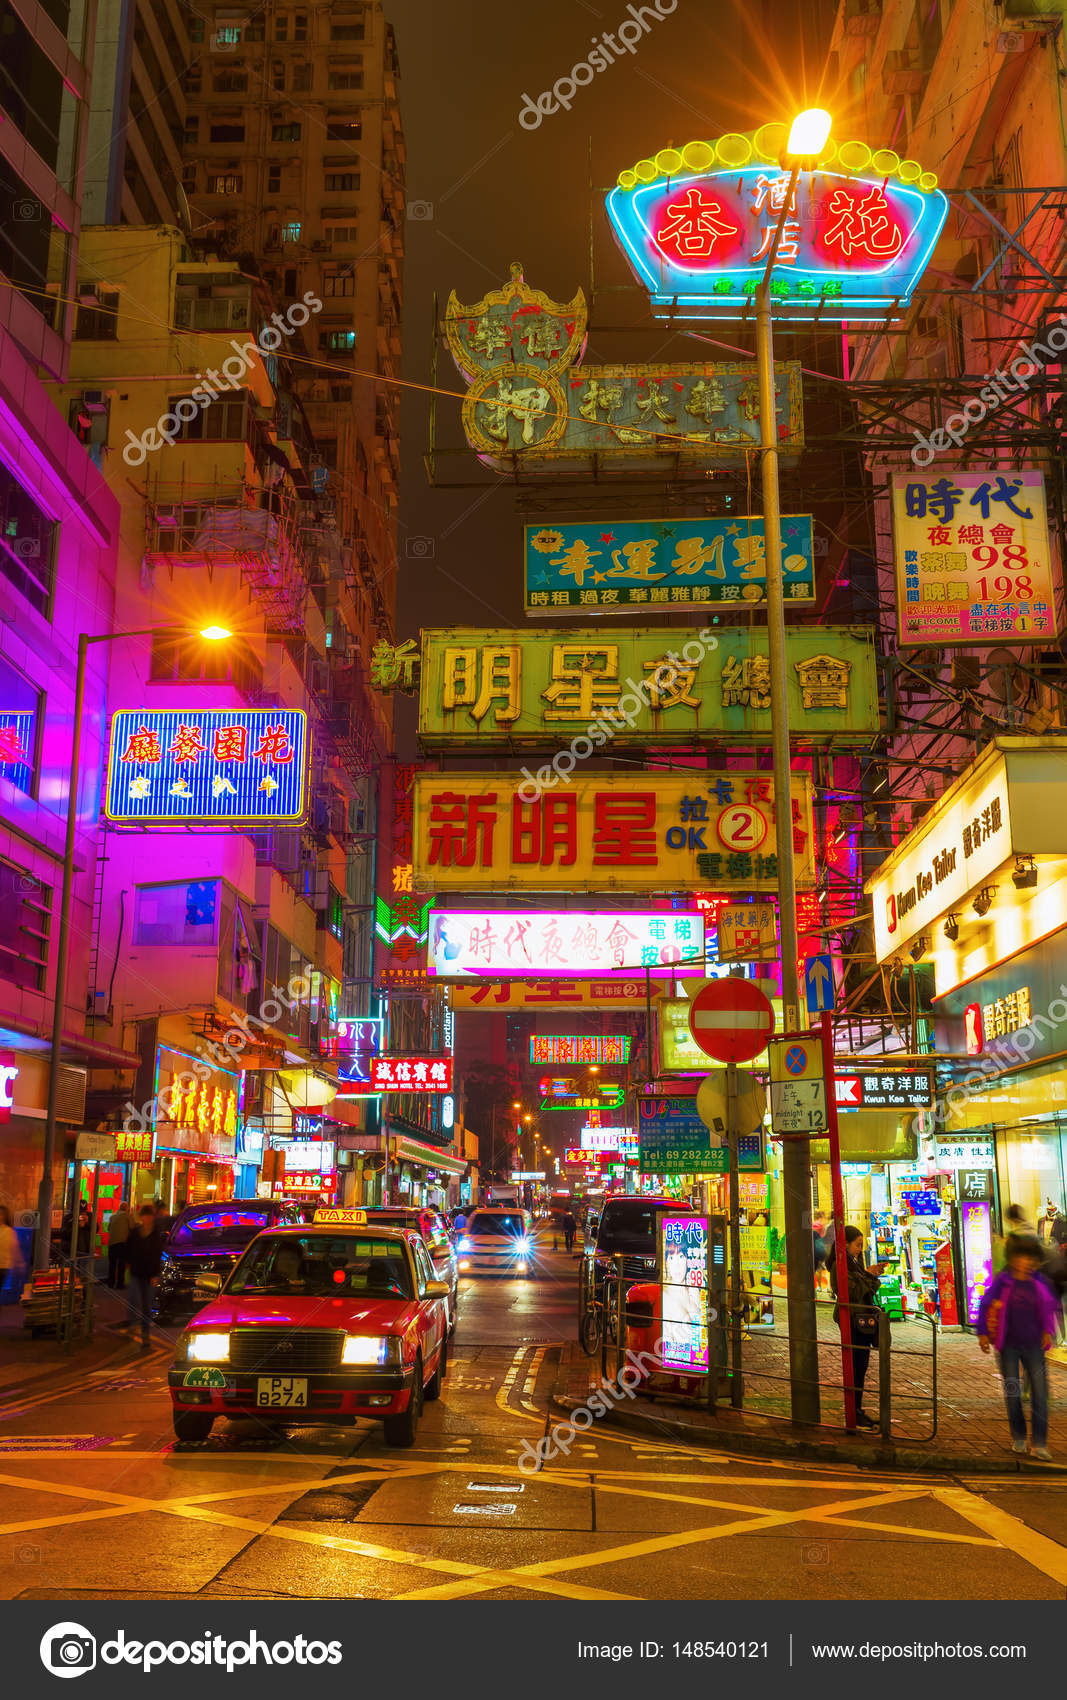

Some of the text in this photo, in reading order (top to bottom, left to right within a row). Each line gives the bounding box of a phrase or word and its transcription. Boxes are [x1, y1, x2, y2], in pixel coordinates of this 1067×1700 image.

[481, 380, 551, 444] 押
[906, 477, 1033, 524] 時代
[927, 523, 1015, 546] 夜總會
[550, 535, 786, 586] 幸運別墅
[972, 545, 1028, 571] 98
[531, 591, 570, 606] 時租
[580, 589, 619, 605] 過夜
[629, 586, 711, 603] 華麗雅靜
[976, 576, 1034, 601] 198
[970, 602, 1047, 616] 盡在不言中
[908, 617, 960, 626] WELCOME
[371, 638, 421, 691] 新
[429, 792, 658, 867] 新明星
[897, 847, 957, 920] Kwun Kee Tailor
[648, 919, 691, 940] 電梯
[468, 918, 640, 966] 時代夜總會
[376, 1062, 447, 1082] 誠信賓館
[811, 1083, 820, 1100] 7
[864, 1076, 929, 1091] 觀奇洋服
[782, 1091, 798, 1102] 上午
[864, 1094, 929, 1103] Kwun Kee Tailor
[776, 1109, 803, 1118] midnight
[808, 1110, 823, 1127] 12
[643, 1150, 724, 1159] Tel: 69 282 282
[939, 1147, 964, 1157] 皮膚
[967, 1190, 985, 1198] 4/F
[318, 1211, 362, 1222] TAXI
[666, 1222, 704, 1244] 時代
[690, 1270, 703, 1286] 98
[271, 1378, 294, 1392] PJ
[259, 1392, 305, 1406] 8274
